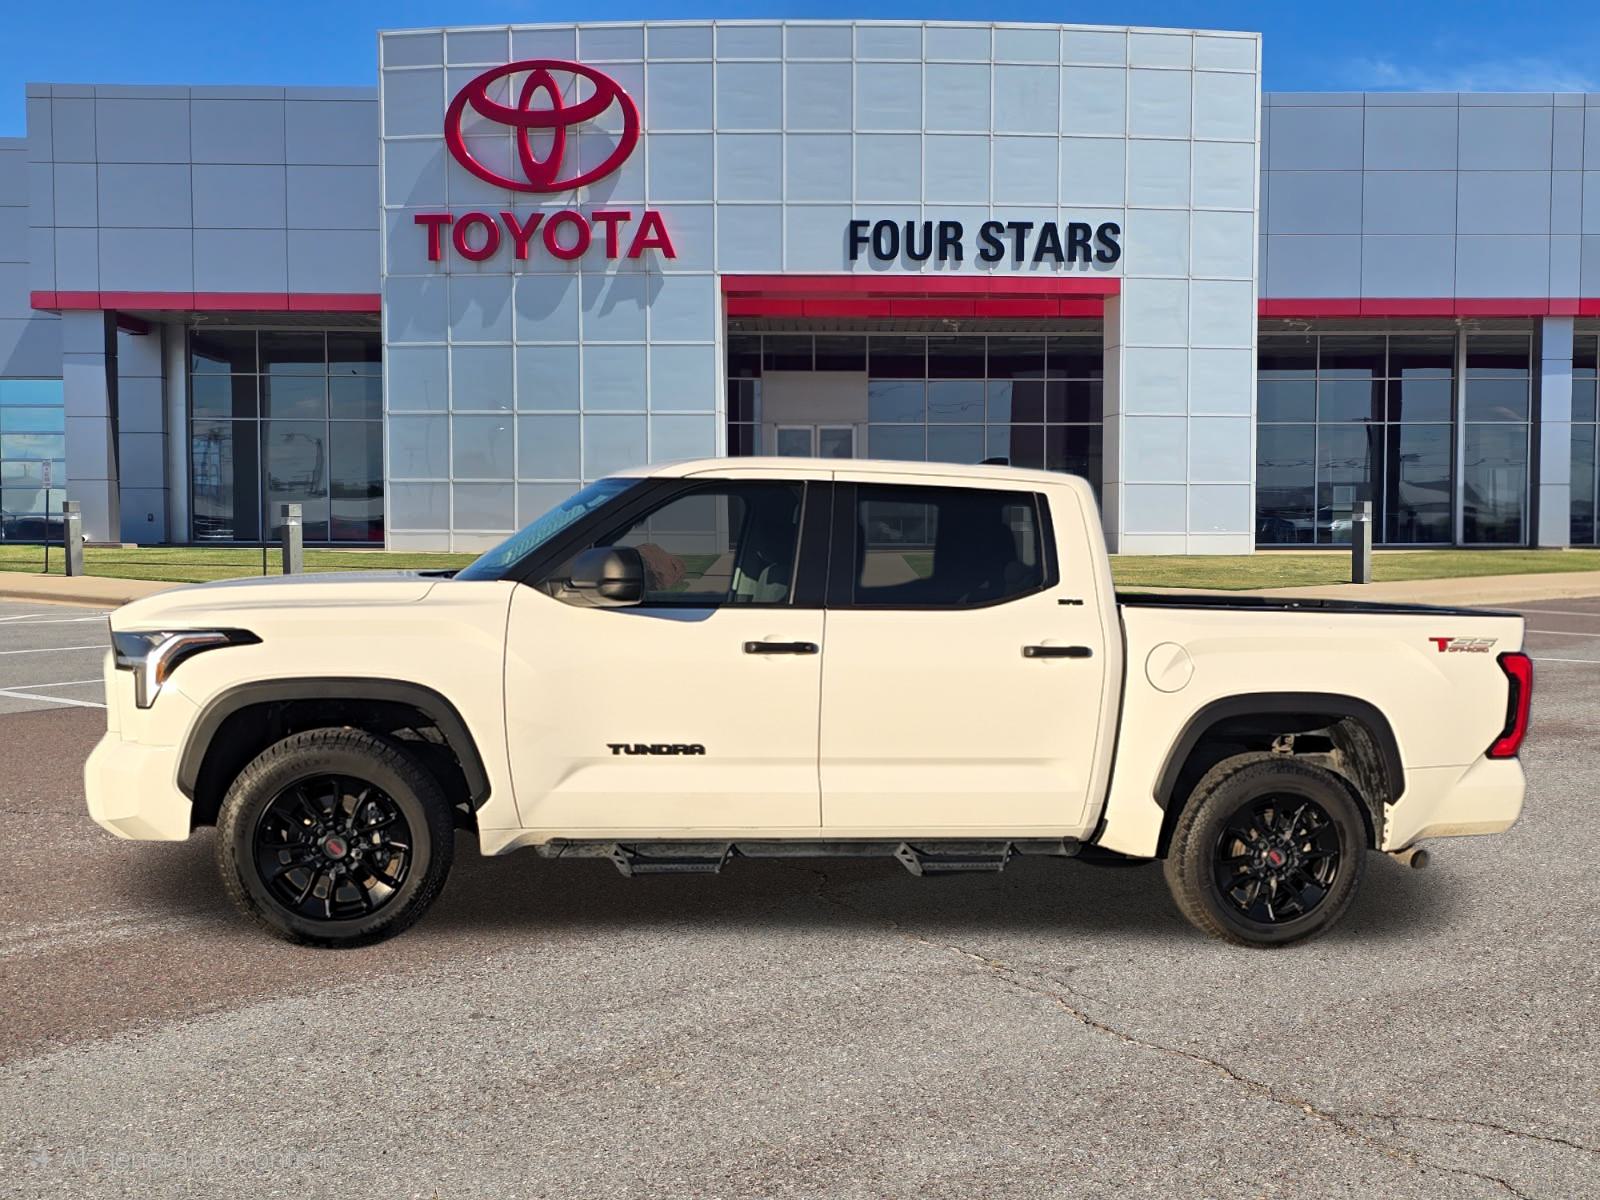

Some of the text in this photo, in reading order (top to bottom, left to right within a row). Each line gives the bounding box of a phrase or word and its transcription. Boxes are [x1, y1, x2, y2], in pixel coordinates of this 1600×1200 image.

[414, 210, 677, 262] TOYOTA
[849, 220, 1121, 263] FOUR STARS
[606, 743, 706, 755] TUNDRA
